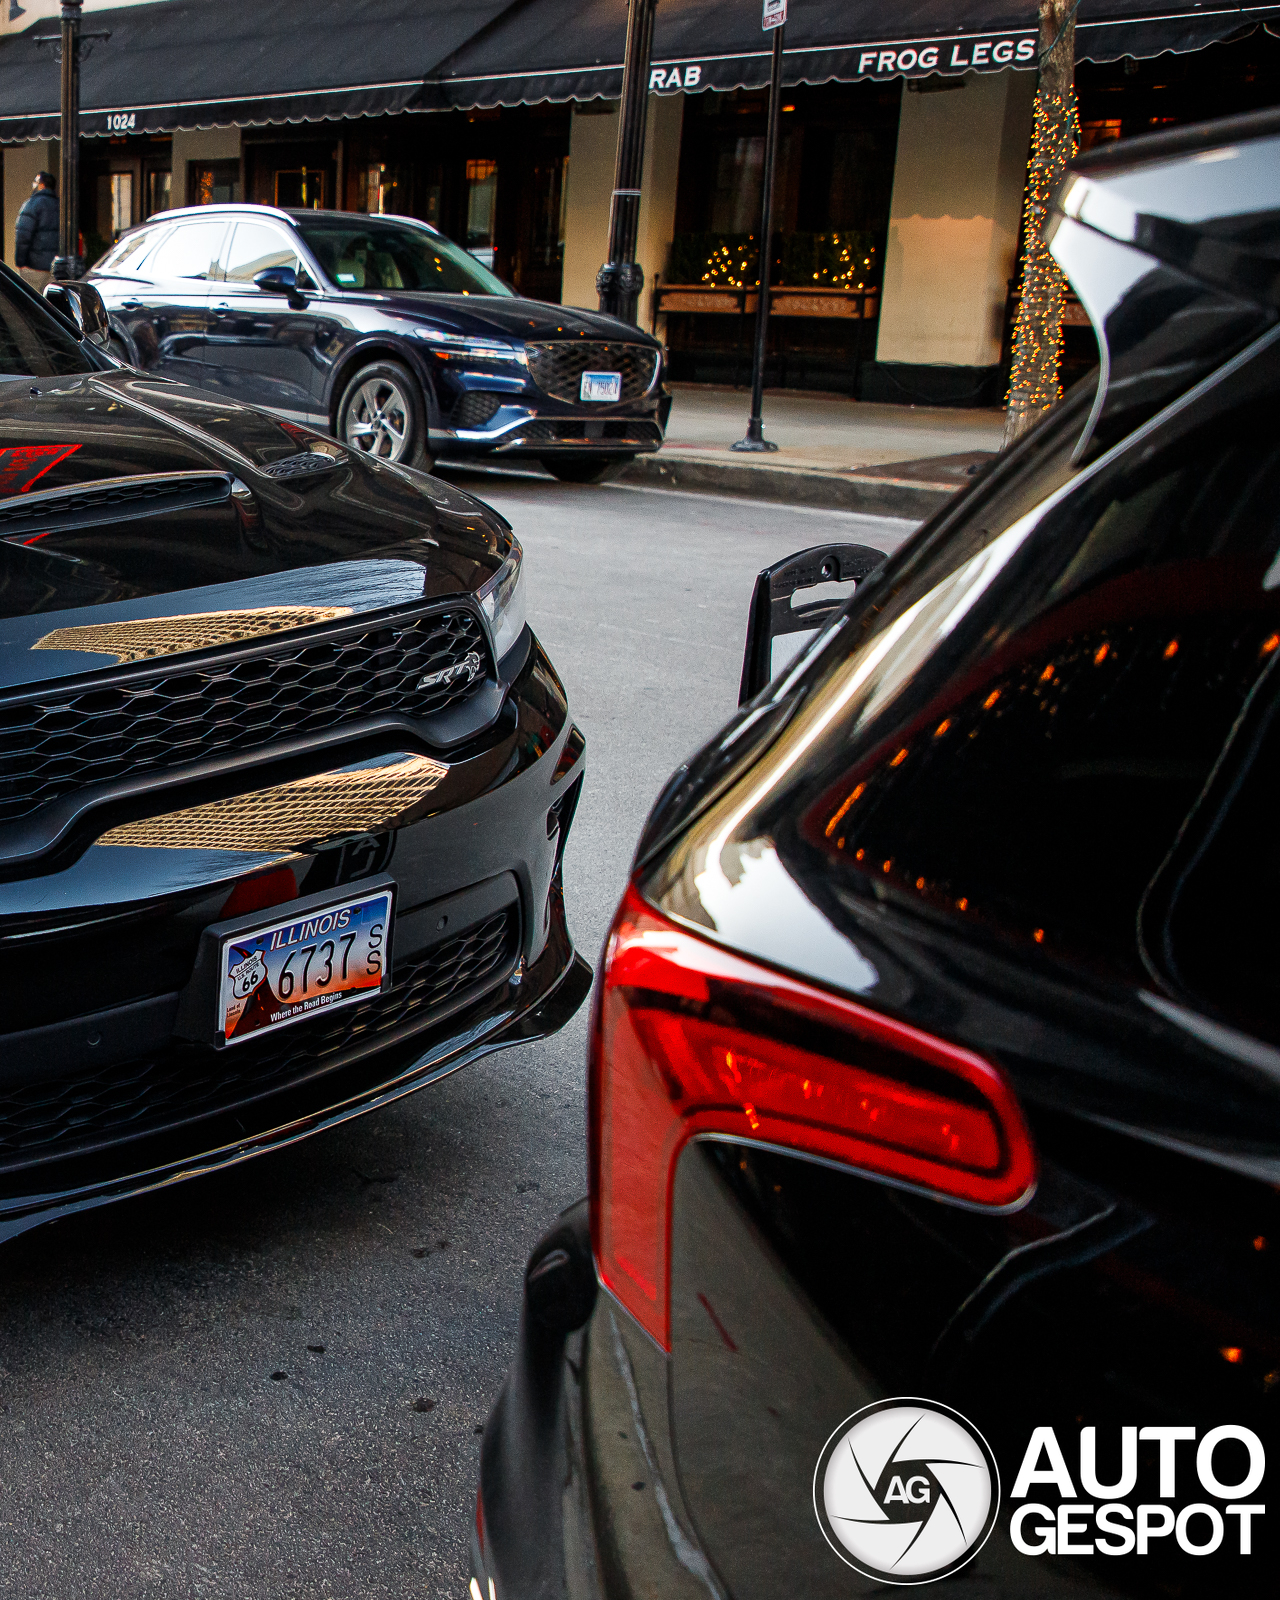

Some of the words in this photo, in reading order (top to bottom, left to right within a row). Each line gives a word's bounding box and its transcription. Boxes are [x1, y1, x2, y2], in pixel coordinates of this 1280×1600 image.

[858, 47, 939, 74] FROG
[950, 38, 1036, 66] LEGS
[648, 65, 702, 89] RAB
[107, 113, 136, 130] 1024
[270, 909, 352, 951] ILLINOIS
[236, 956, 258, 974] ILLINOIS
[278, 930, 357, 999] 6737
[242, 970, 259, 992] 66
[270, 1009, 291, 1022] Where
[292, 1005, 303, 1014] the
[304, 998, 320, 1010] Road
[320, 991, 342, 1004] Begins
